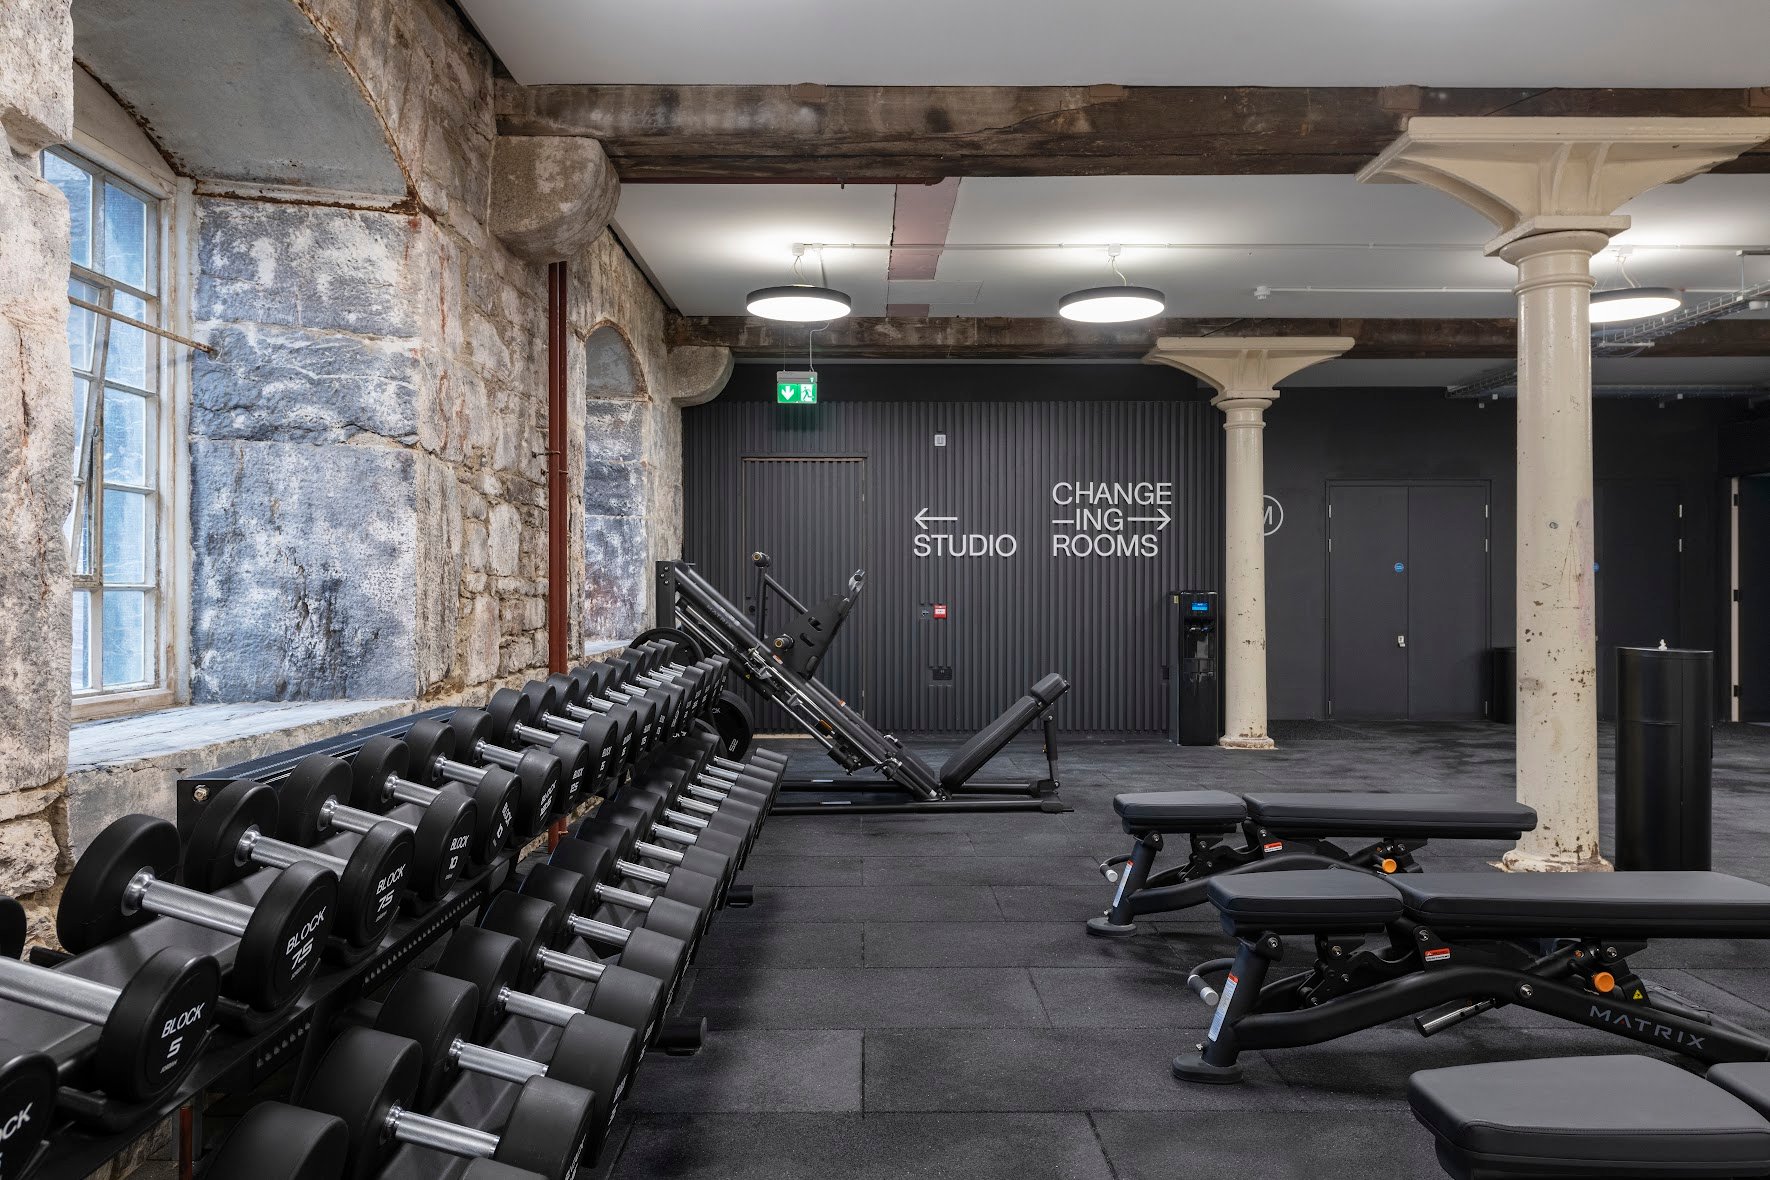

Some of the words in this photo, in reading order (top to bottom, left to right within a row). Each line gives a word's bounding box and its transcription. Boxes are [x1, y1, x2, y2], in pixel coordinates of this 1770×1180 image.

[1052, 481, 1172, 505] CHANGE
[913, 533, 1017, 557] STUDIO
[1053, 533, 1159, 557] ROOMS
[449, 834, 470, 851] BLOCK
[376, 863, 407, 895] BLOCK
[285, 905, 327, 956] BLOCK
[160, 1002, 206, 1039] BLOCK
[1589, 1005, 1706, 1050] MATRIX
[166, 1036, 184, 1059] 5
